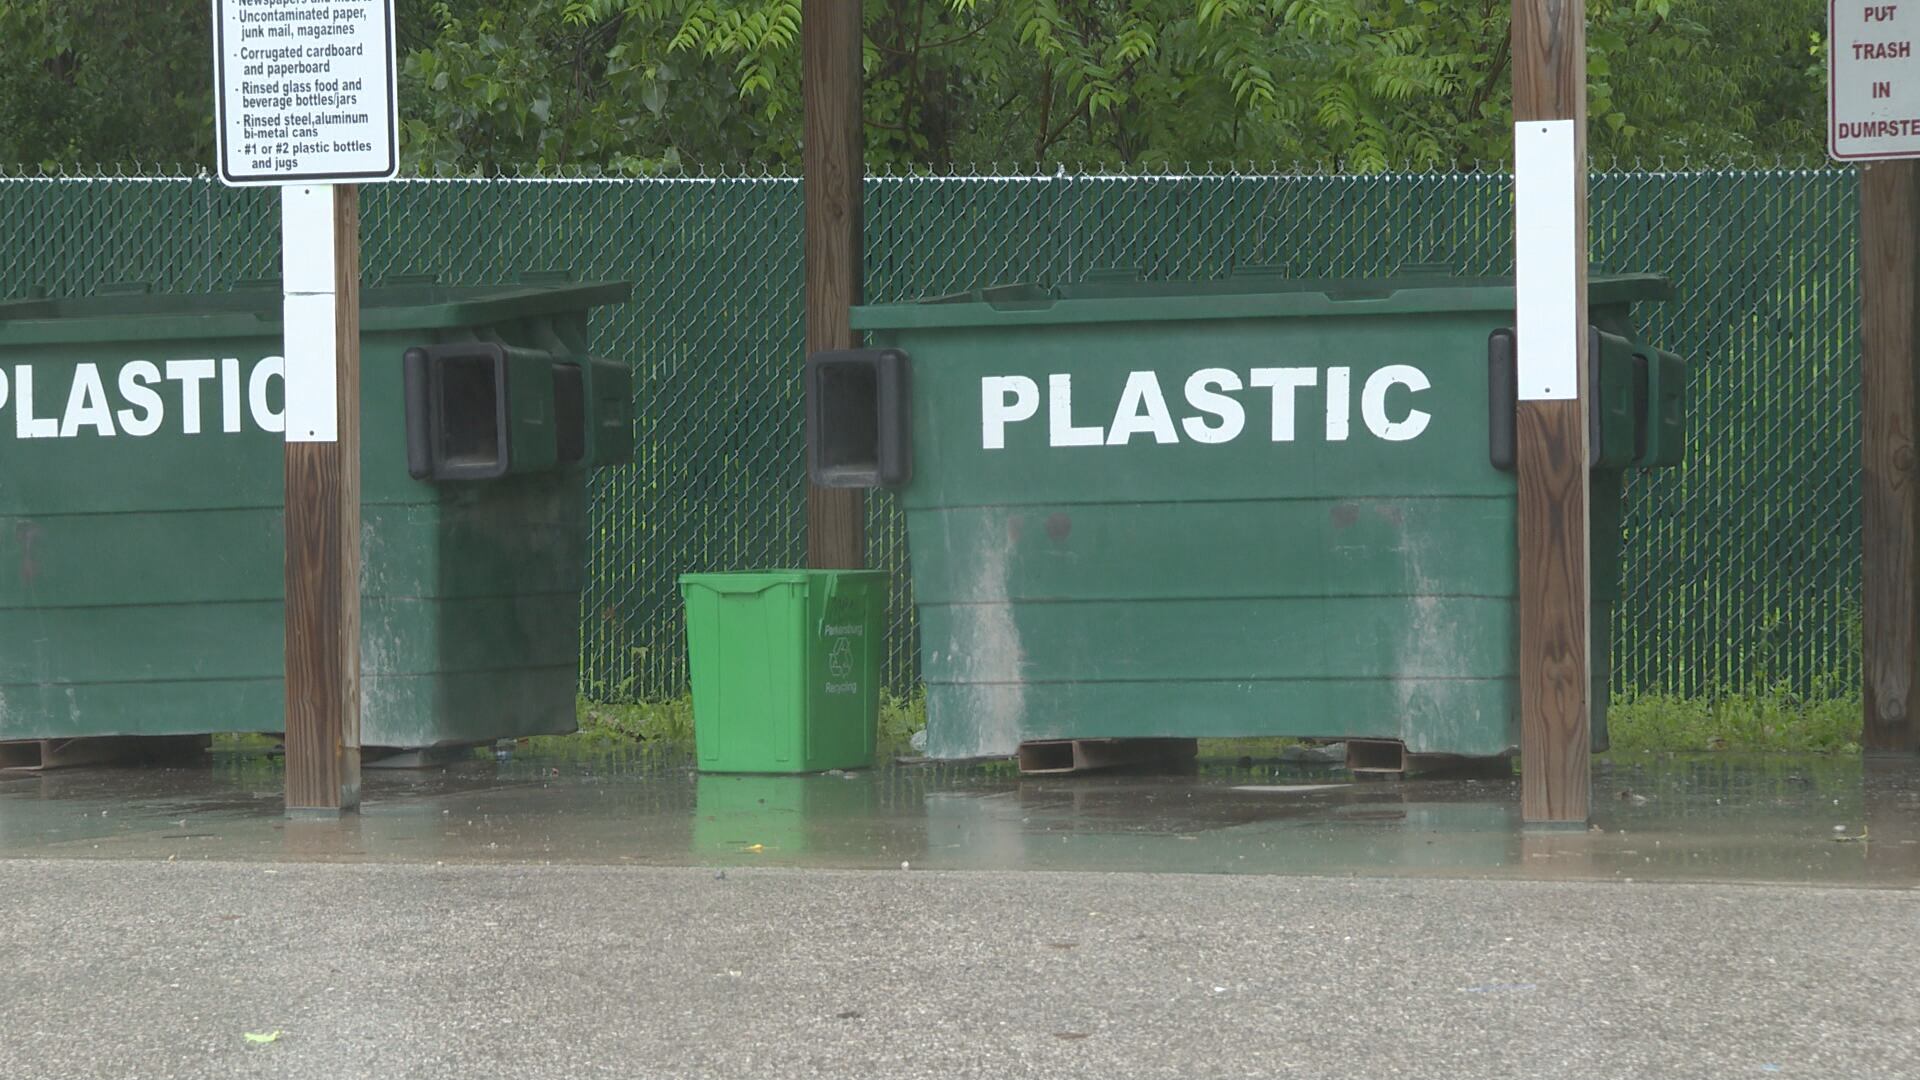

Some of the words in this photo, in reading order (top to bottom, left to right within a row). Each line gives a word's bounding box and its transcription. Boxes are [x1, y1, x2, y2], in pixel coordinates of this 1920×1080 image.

[239, 6, 329, 23] Uncontaminated
[333, 8, 367, 22] paper,
[1864, 6, 1897, 22] PUT
[241, 25, 265, 41] junk
[268, 23, 294, 39] mail,
[297, 23, 355, 39] magazines
[240, 45, 303, 62] Corrugated
[306, 43, 363, 58] cardboard
[1852, 41, 1911, 60] TRASH
[244, 62, 264, 76] and
[267, 60, 330, 77] paperboard
[242, 80, 279, 95] Rinsed
[282, 80, 312, 96] glass
[315, 78, 338, 92] food
[342, 78, 362, 91] and
[1872, 81, 1891, 98] IN
[243, 95, 293, 110] beverage
[296, 92, 357, 109] bottles/jars
[243, 113, 281, 128] Rinsed
[244, 127, 289, 140] bi-metal
[292, 128, 318, 138] cans
[244, 143, 257, 156] #1
[261, 145, 273, 155] or
[276, 142, 289, 154] #2
[292, 141, 330, 156] plastic
[333, 140, 372, 153] bottles
[252, 157, 272, 170] and
[275, 156, 298, 171] jugs
[0, 355, 285, 439] LASTIC
[981, 364, 1432, 450] PLASTIC
[825, 681, 857, 695] Recycling
